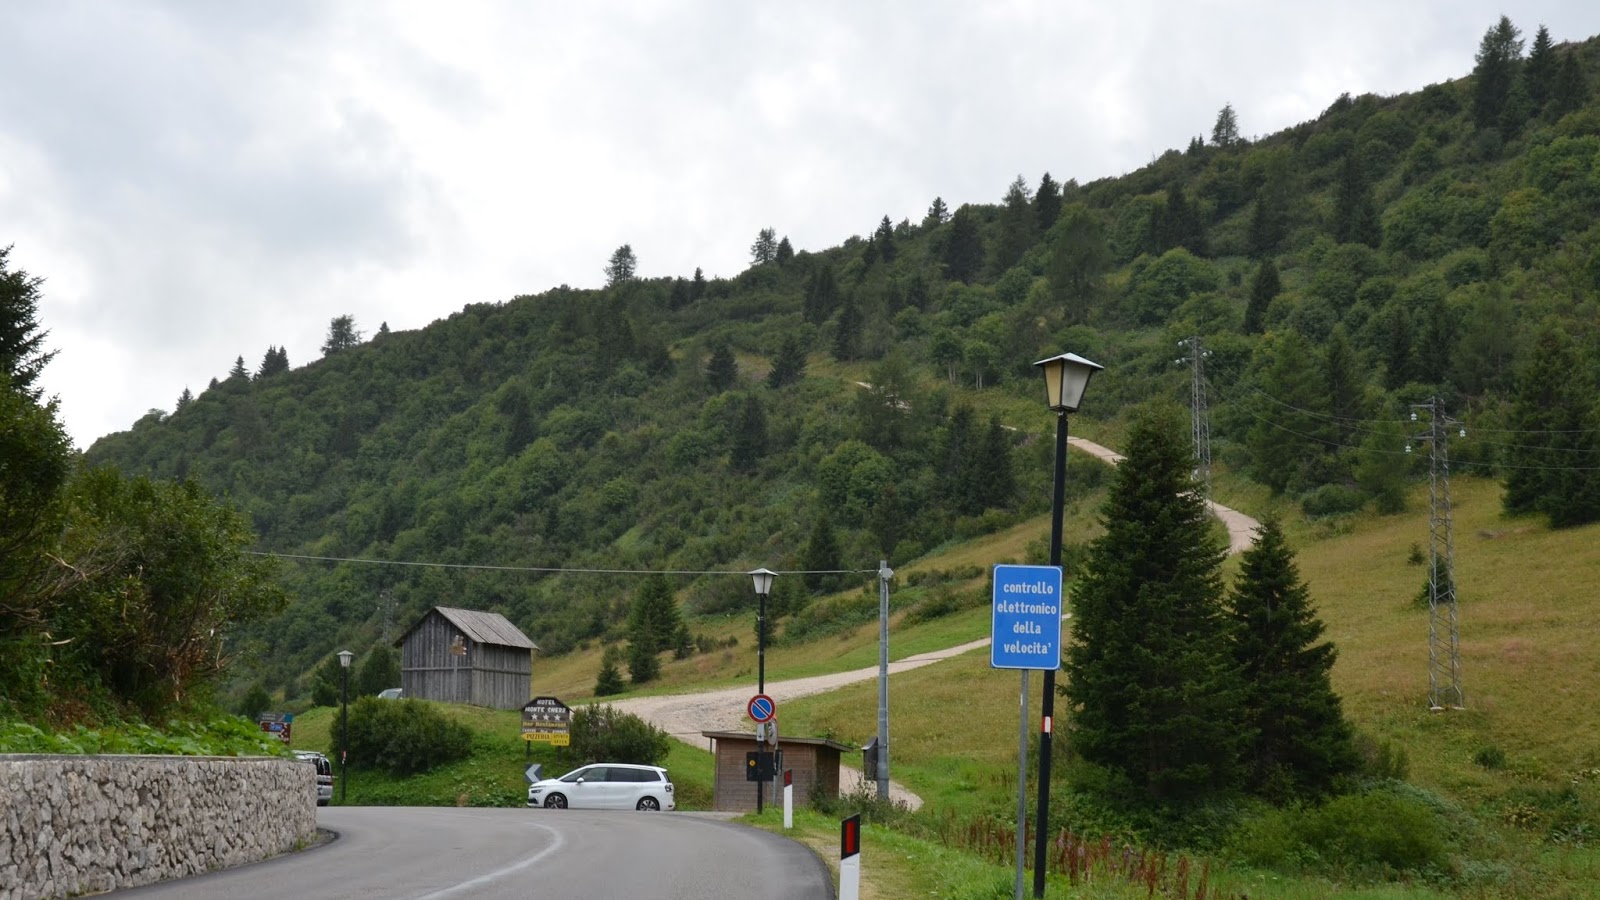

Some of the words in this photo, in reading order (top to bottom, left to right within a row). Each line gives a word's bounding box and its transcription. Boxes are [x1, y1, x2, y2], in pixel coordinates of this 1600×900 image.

[1003, 581, 1053, 594] controllo
[997, 600, 1057, 615] elettronico
[1013, 621, 1041, 634] della
[1003, 641, 1052, 654] velocita'
